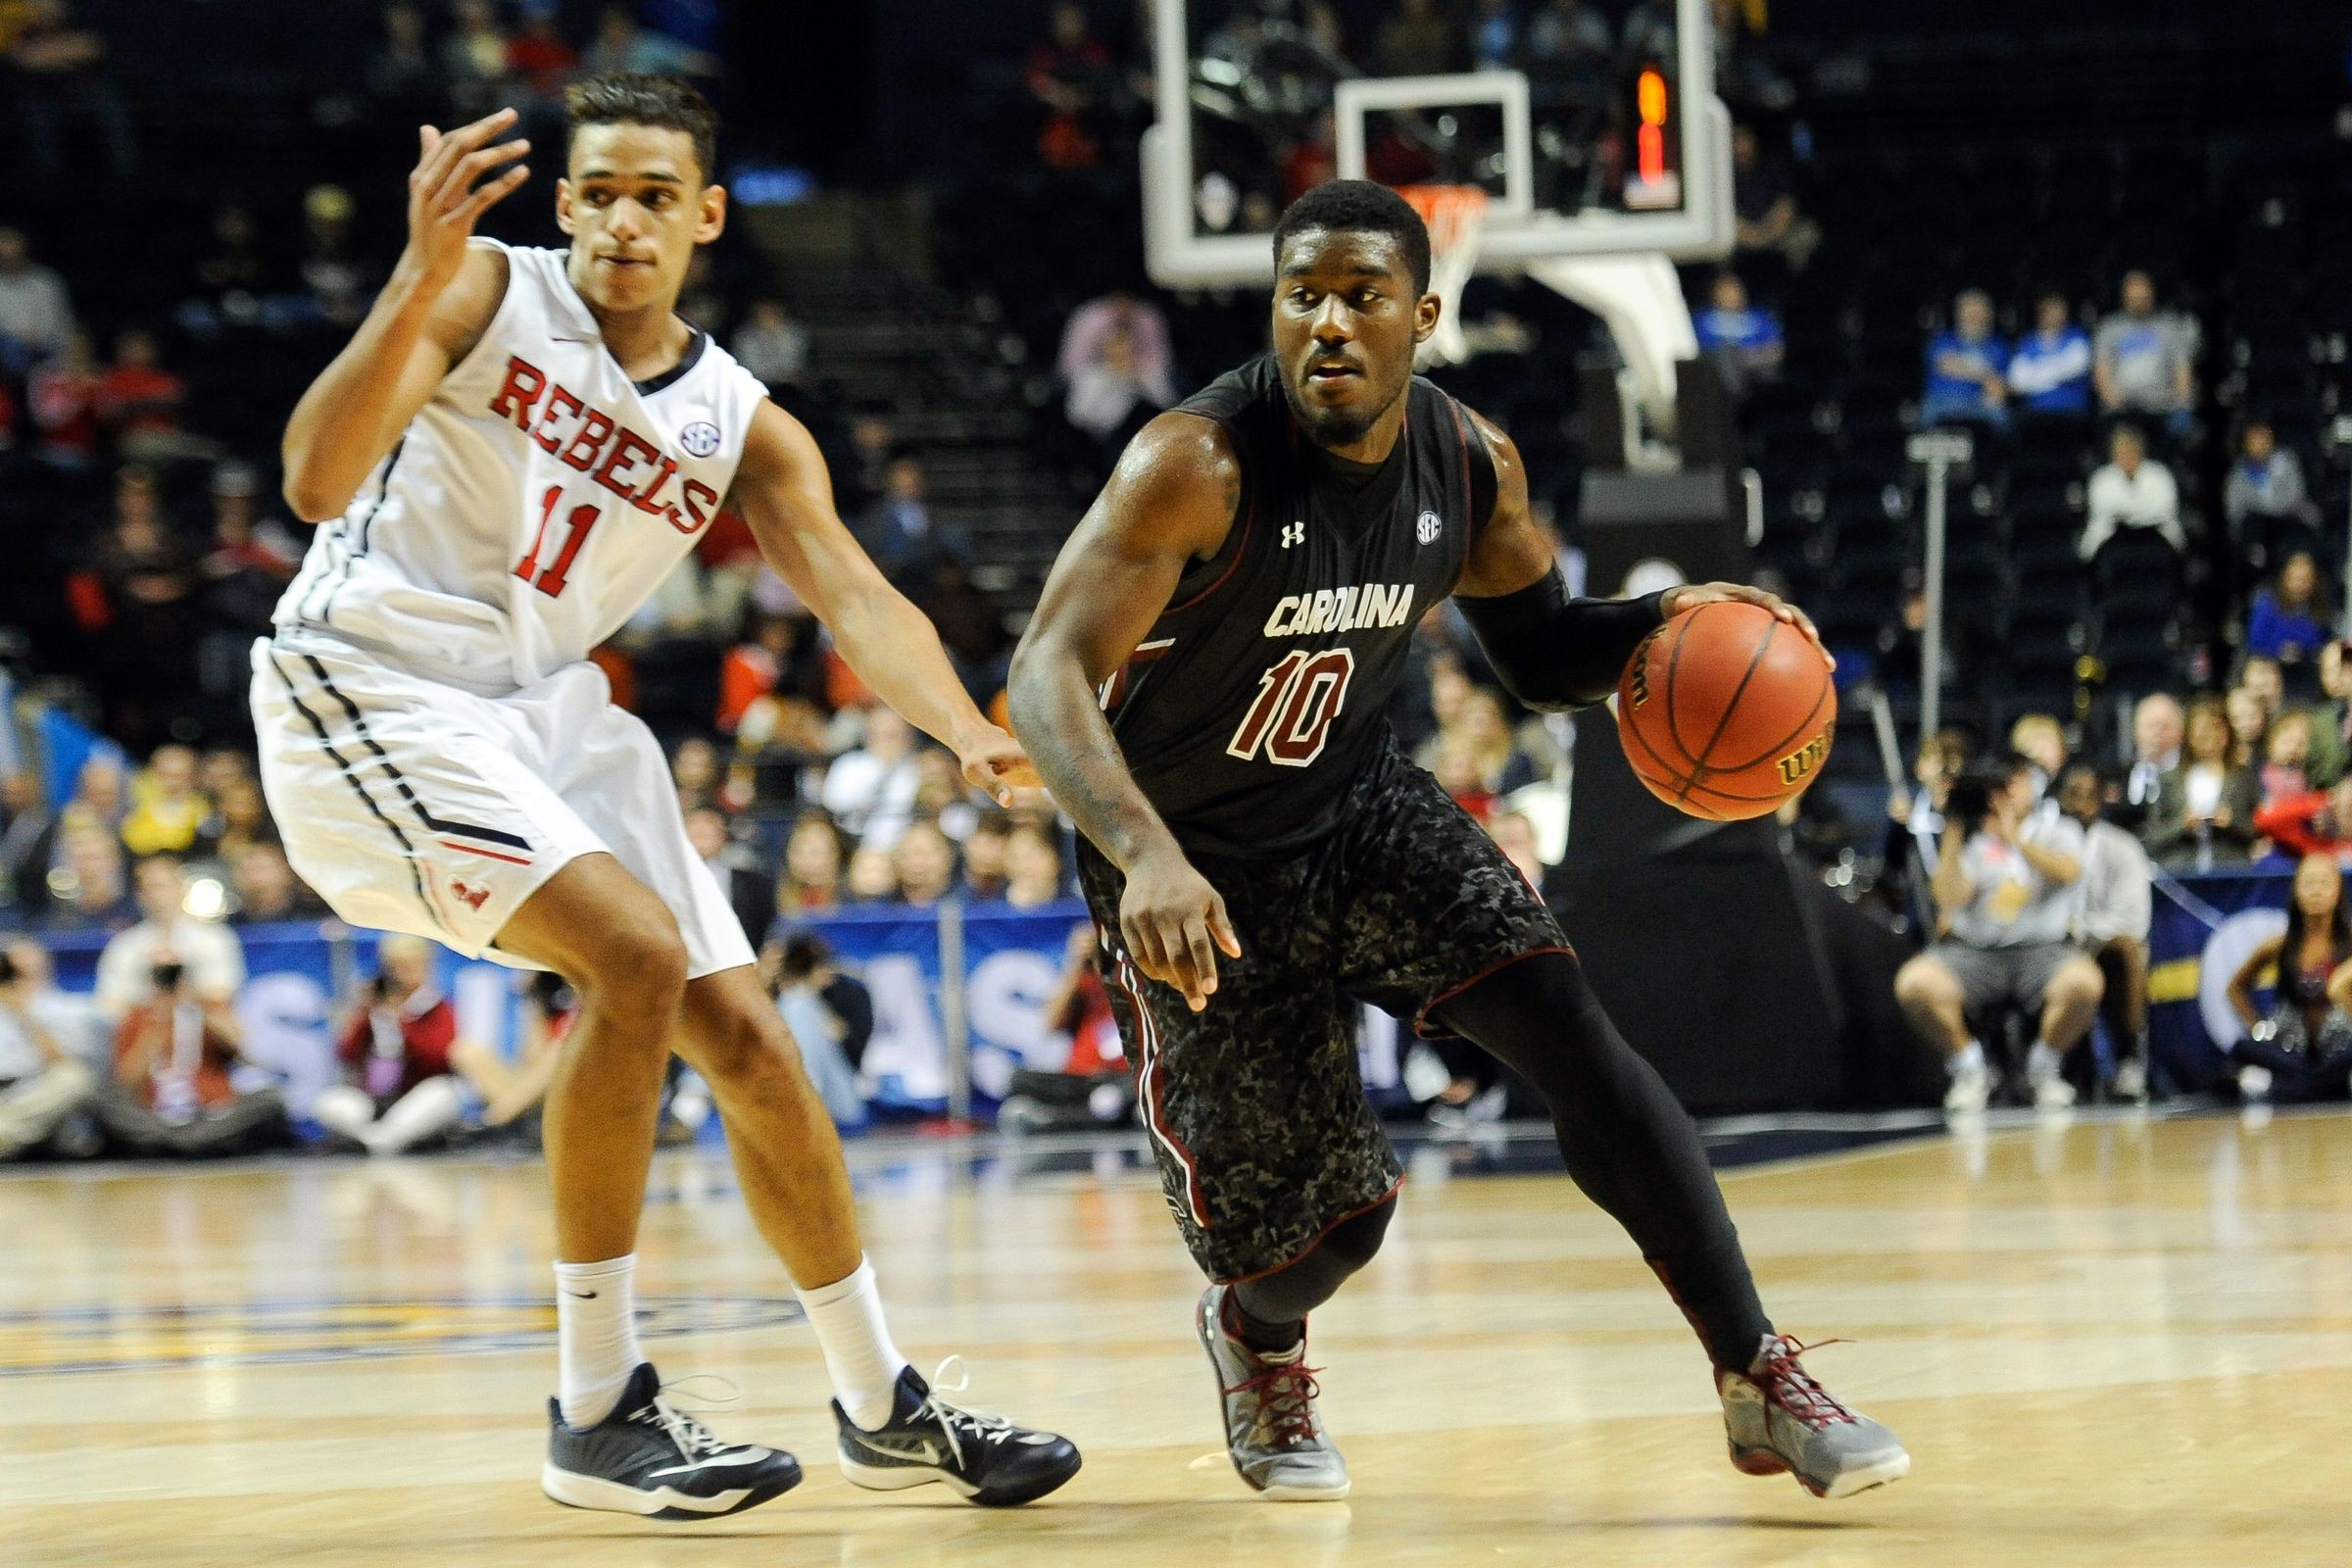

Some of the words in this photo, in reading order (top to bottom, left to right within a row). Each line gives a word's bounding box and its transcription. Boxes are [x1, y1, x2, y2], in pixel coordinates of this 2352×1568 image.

[488, 355, 718, 534] REBELS
[512, 485, 601, 598] 11
[1417, 511, 1442, 545] SEC
[1263, 583, 1415, 637] CAROLINA
[1226, 647, 1354, 767] 10
